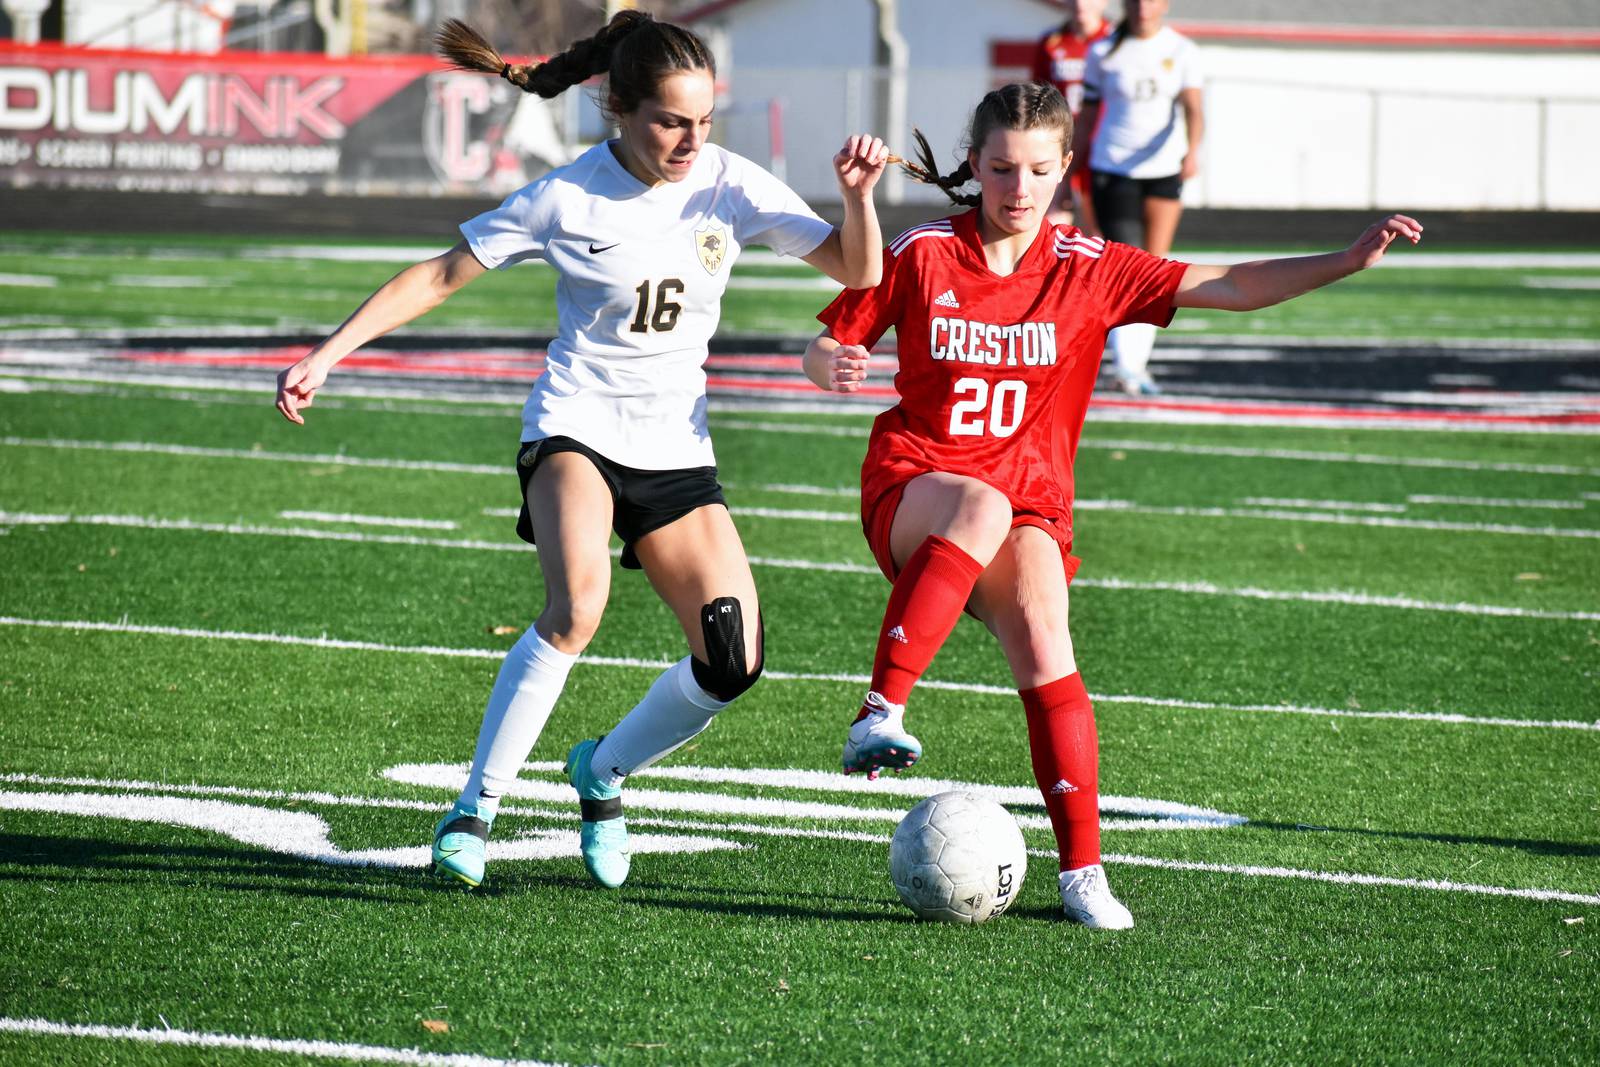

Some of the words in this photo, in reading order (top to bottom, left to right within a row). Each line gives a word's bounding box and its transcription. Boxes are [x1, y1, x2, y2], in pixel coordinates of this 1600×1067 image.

[630, 278, 685, 333] 16
[934, 298, 960, 309] adidas
[931, 317, 1057, 366] CRESTON
[949, 377, 1028, 438] 20
[721, 605, 732, 614] KT
